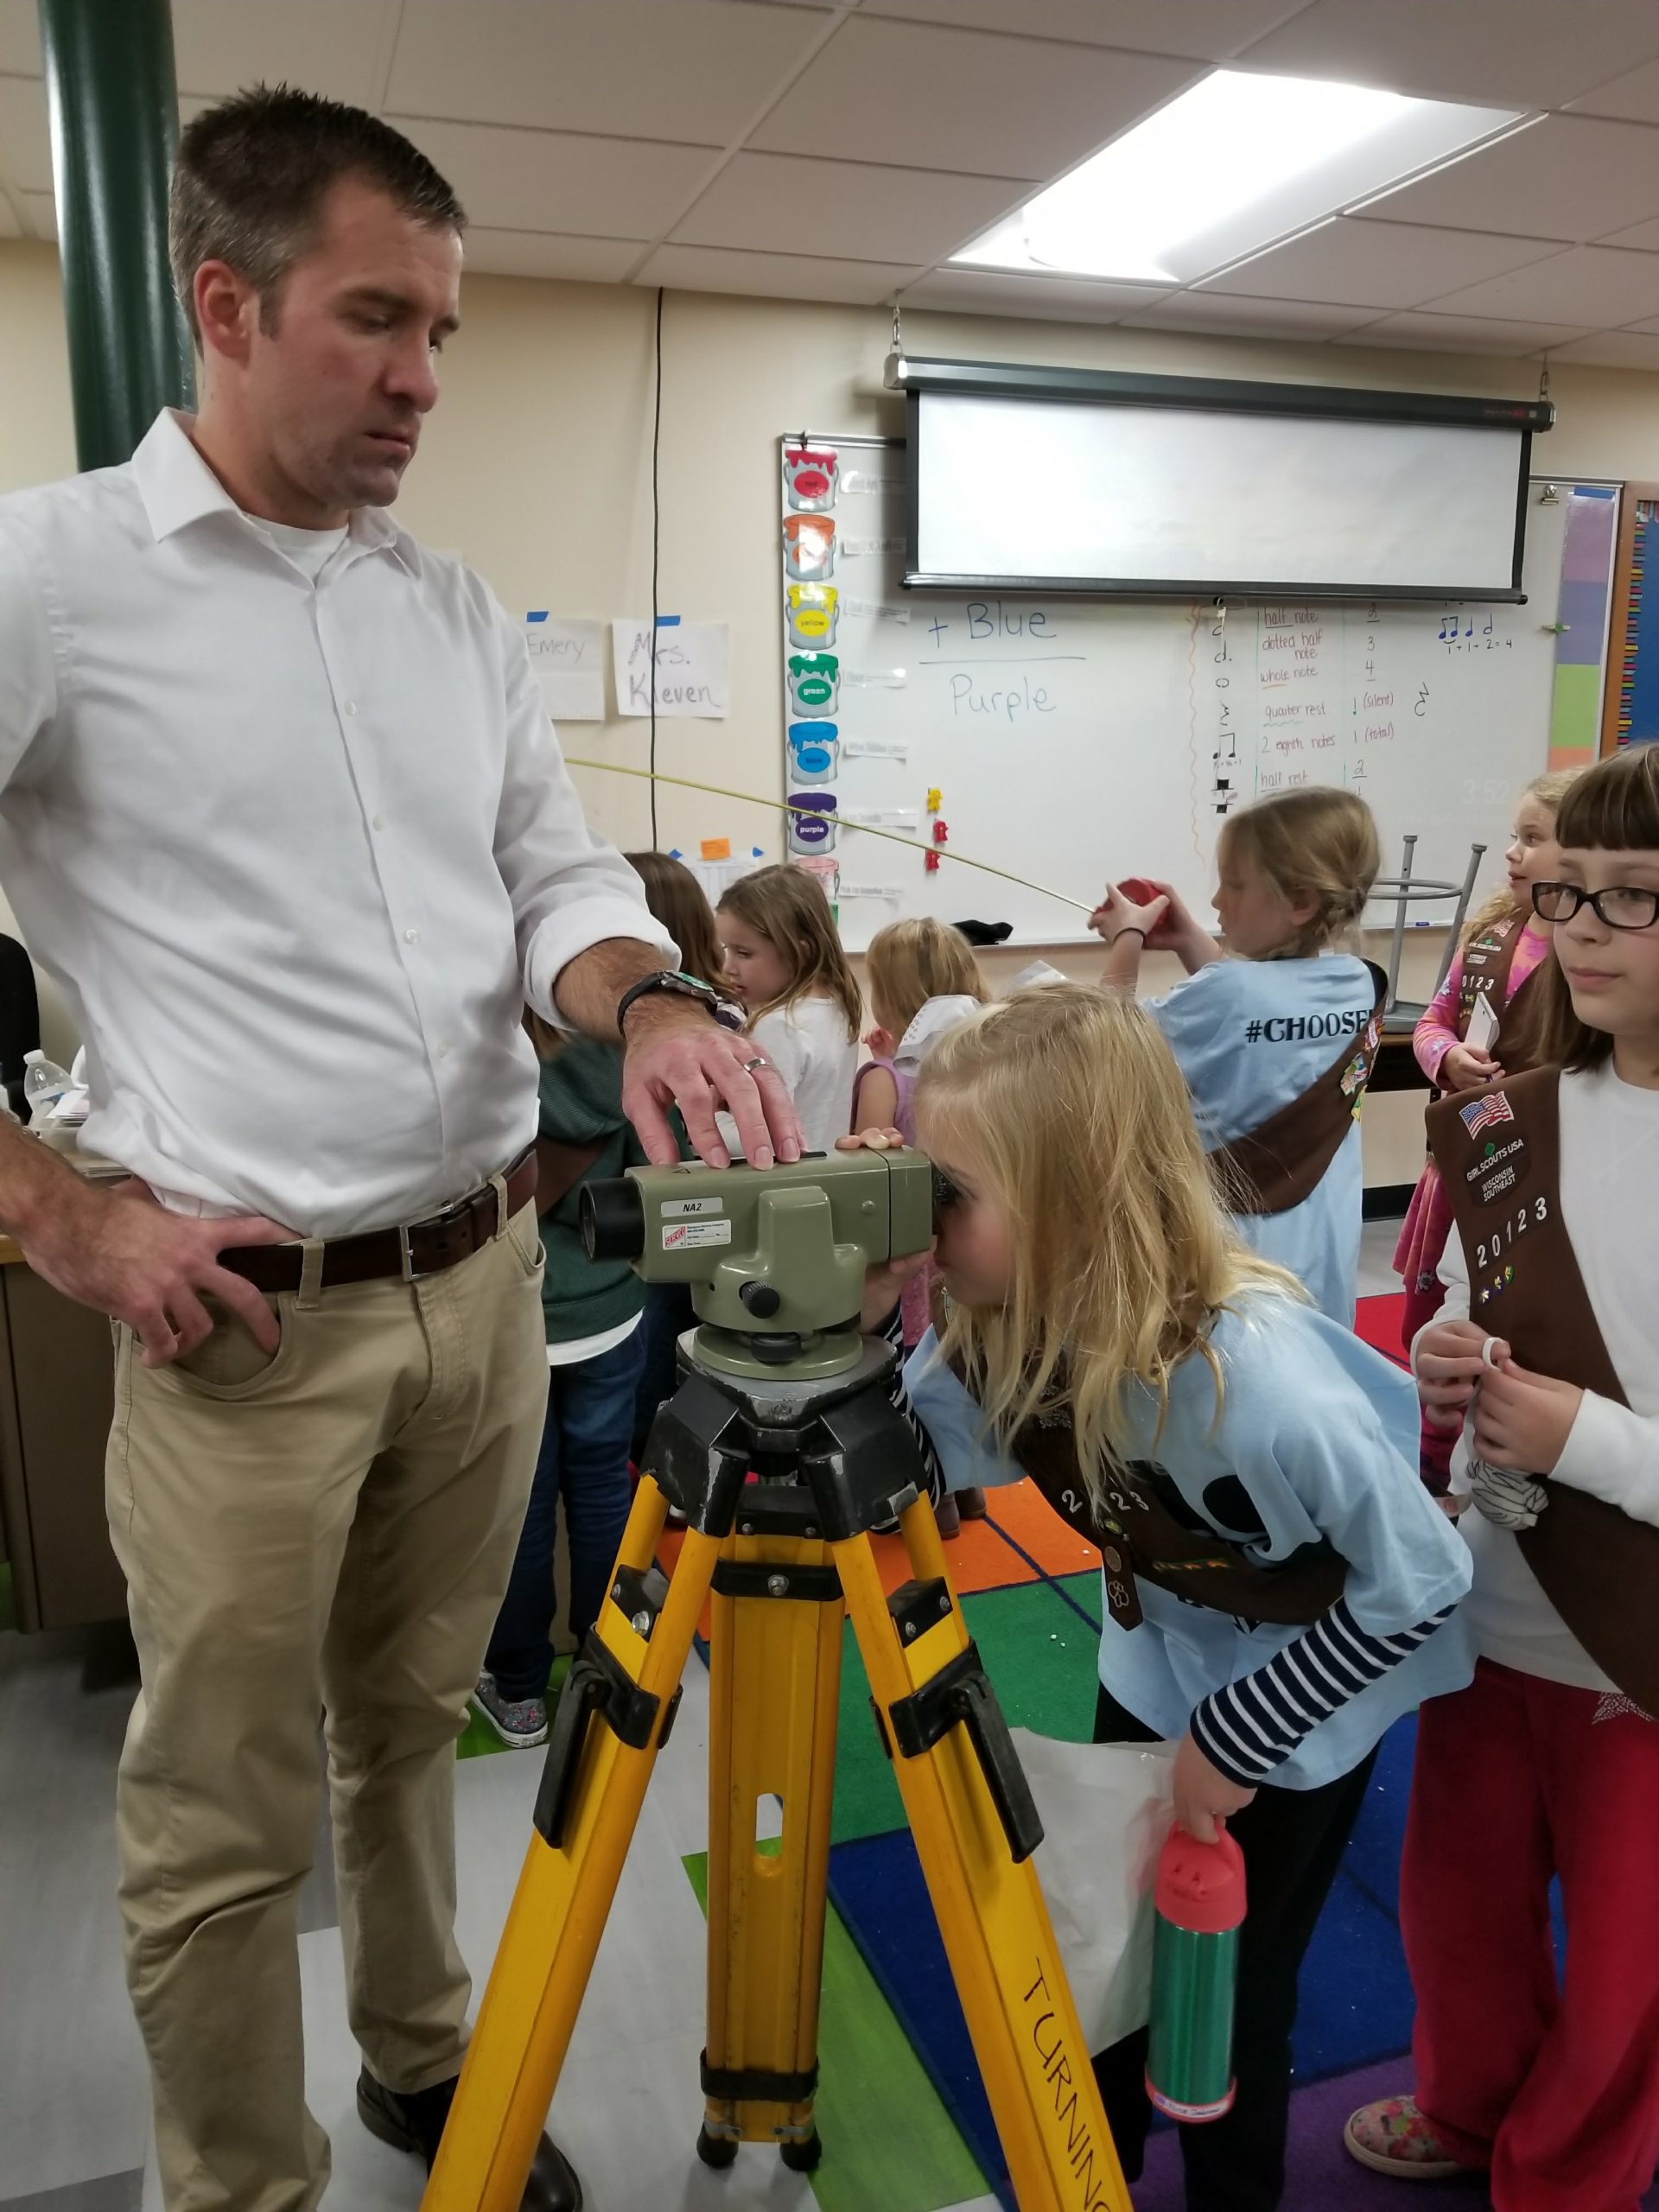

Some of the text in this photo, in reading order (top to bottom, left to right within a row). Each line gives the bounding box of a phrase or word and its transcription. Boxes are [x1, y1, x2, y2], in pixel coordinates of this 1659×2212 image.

[967, 600, 1057, 639] Blue
[1264, 607, 1319, 626] half note
[627, 632, 690, 665] Mrs.
[1262, 628, 1323, 651] dotted half
[1367, 636, 1375, 651] 3
[1486, 639, 1493, 649] 2
[1506, 639, 1512, 649] 4
[1294, 647, 1319, 660] note
[1260, 665, 1318, 683] whole note
[1365, 660, 1375, 675] 4
[950, 674, 1057, 722] Purple
[1363, 691, 1394, 710] (silent)
[1265, 702, 1326, 721] quarter rest
[1364, 721, 1395, 743] (total)
[1262, 736, 1271, 753] 2
[1311, 734, 1335, 749] notes
[1354, 759, 1364, 775] 2
[1260, 770, 1307, 787] half rest
[799, 826, 824, 835] purple
[1466, 1138, 1524, 1182] GIRL SCOUTS USA
[1481, 1166, 1513, 1192] WISCONSIN
[1484, 1173, 1516, 1202] SOUTHEAST
[683, 1203, 702, 1212] NA2
[1477, 1197, 1547, 1268] 20123
